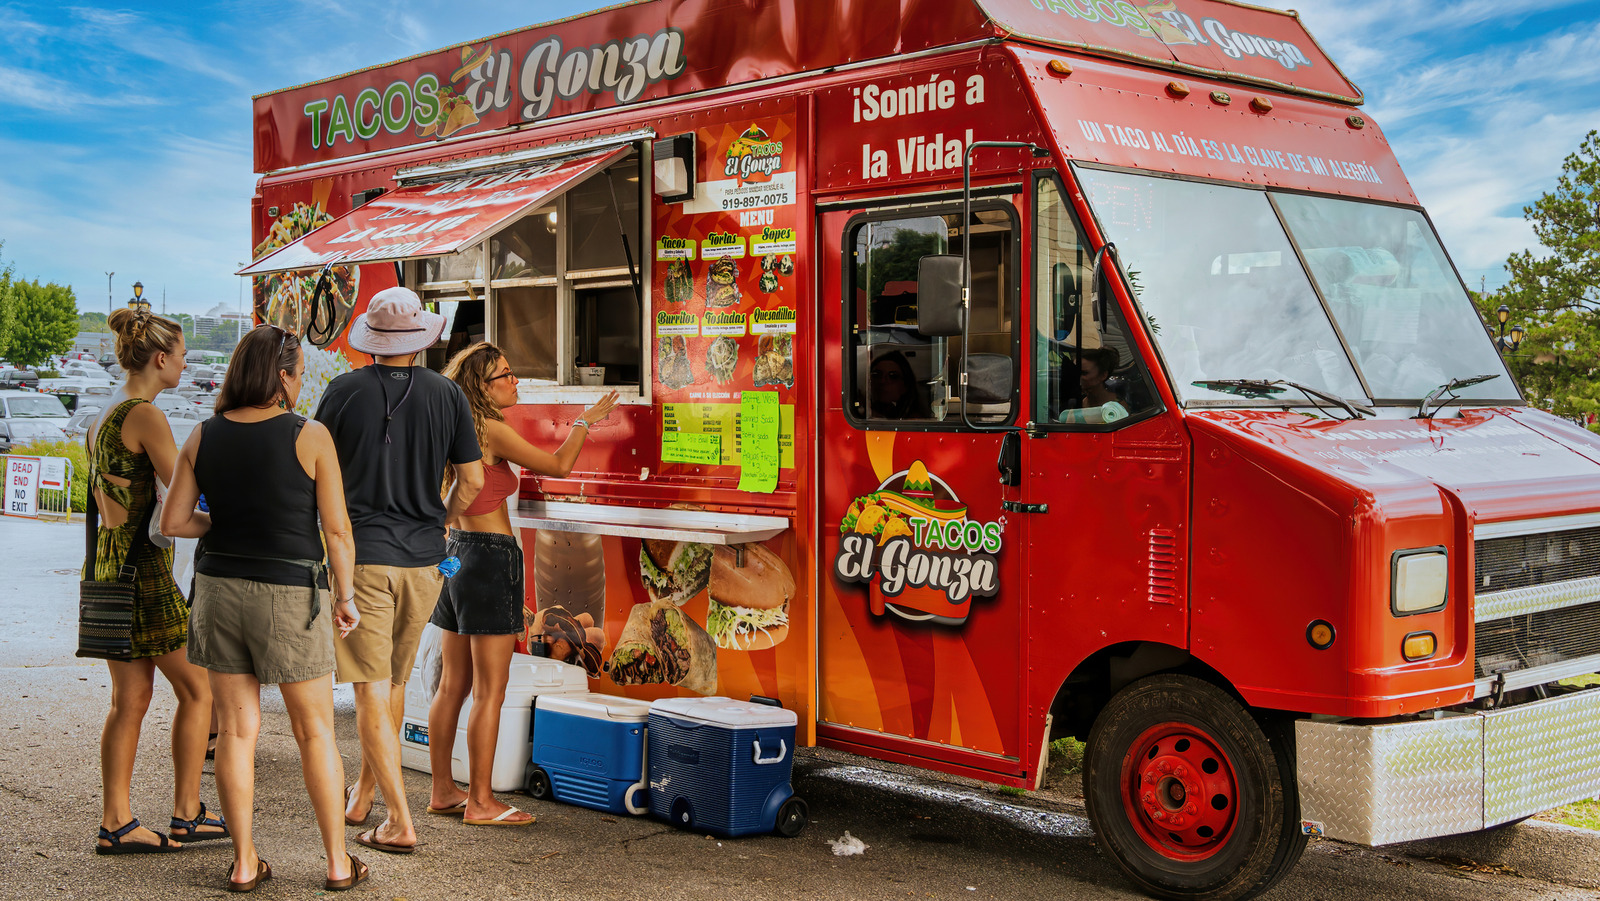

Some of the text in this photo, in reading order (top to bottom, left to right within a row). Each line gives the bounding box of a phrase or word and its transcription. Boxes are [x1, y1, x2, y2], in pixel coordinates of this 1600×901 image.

[1162, 11, 1208, 44] El
[1203, 19, 1311, 69] Gonza
[304, 30, 684, 149] TACOS El Gonza
[853, 74, 985, 123] ¡Sonríe a
[751, 142, 782, 157] TACOS
[862, 129, 974, 179] la Vida!
[1077, 119, 1383, 184] UN TACO AL DÍA ES LA CLAVE DE MI ALEGRÍA
[725, 155, 781, 179] El Gonza
[722, 193, 788, 210] 919-897-0075
[740, 209, 774, 228] MENU
[661, 235, 686, 249] Tacos
[708, 232, 737, 246] Tortas
[762, 227, 792, 243] Sopes
[657, 311, 695, 325] Burritos
[705, 311, 746, 325] Tostadas
[753, 306, 796, 323] Quesadillas
[12, 462, 33, 473] DEAD
[13, 475, 29, 486] END
[14, 489, 26, 499] NO
[12, 501, 28, 512] EXIT
[910, 517, 1001, 553] TACOS
[837, 536, 996, 601] El Gonza
